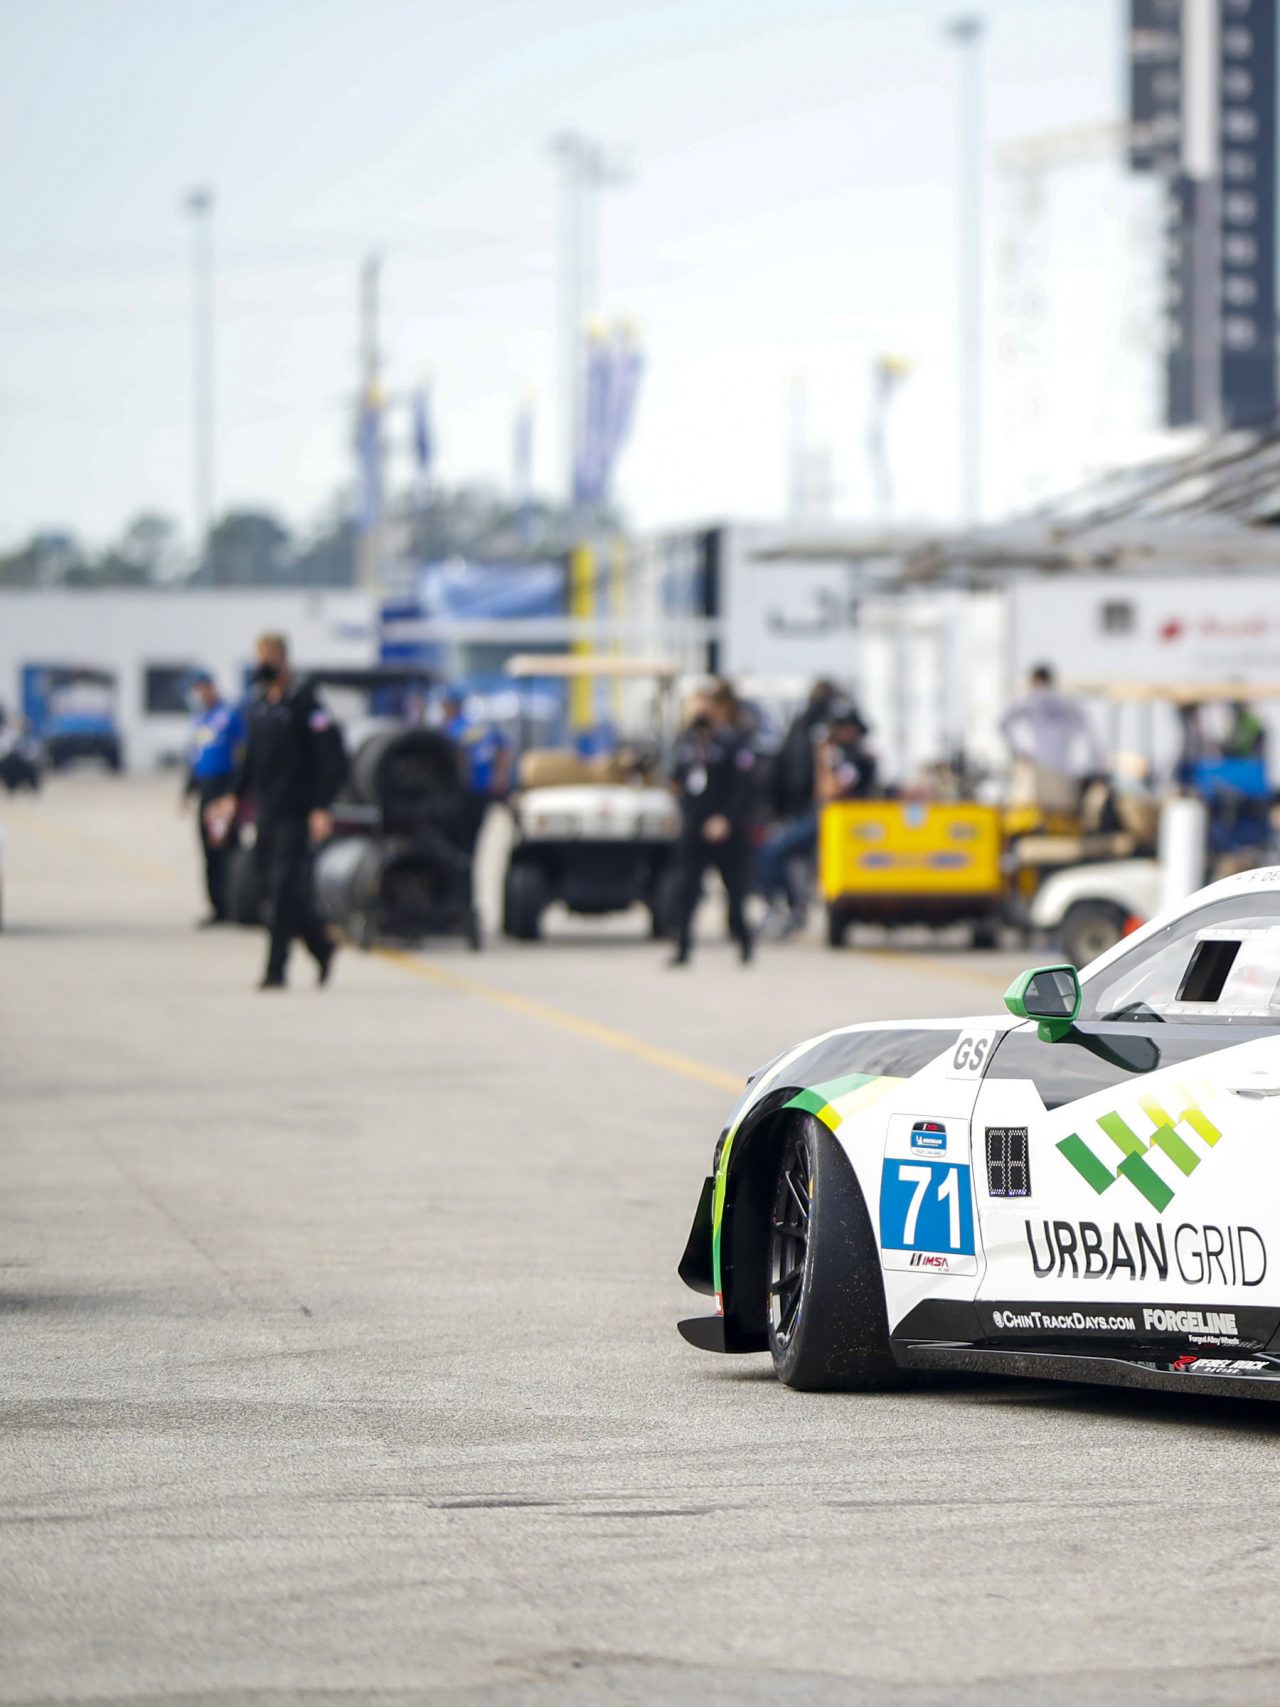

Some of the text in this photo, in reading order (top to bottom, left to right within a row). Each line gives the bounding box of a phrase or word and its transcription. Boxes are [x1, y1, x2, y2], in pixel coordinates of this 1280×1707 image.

[953, 1036, 989, 1070] GS
[898, 1165, 961, 1249] 71
[922, 1255, 949, 1268] IMSA
[1142, 1308, 1239, 1335] FORGELINE
[1191, 1359, 1270, 1371] REBEL ROCK
